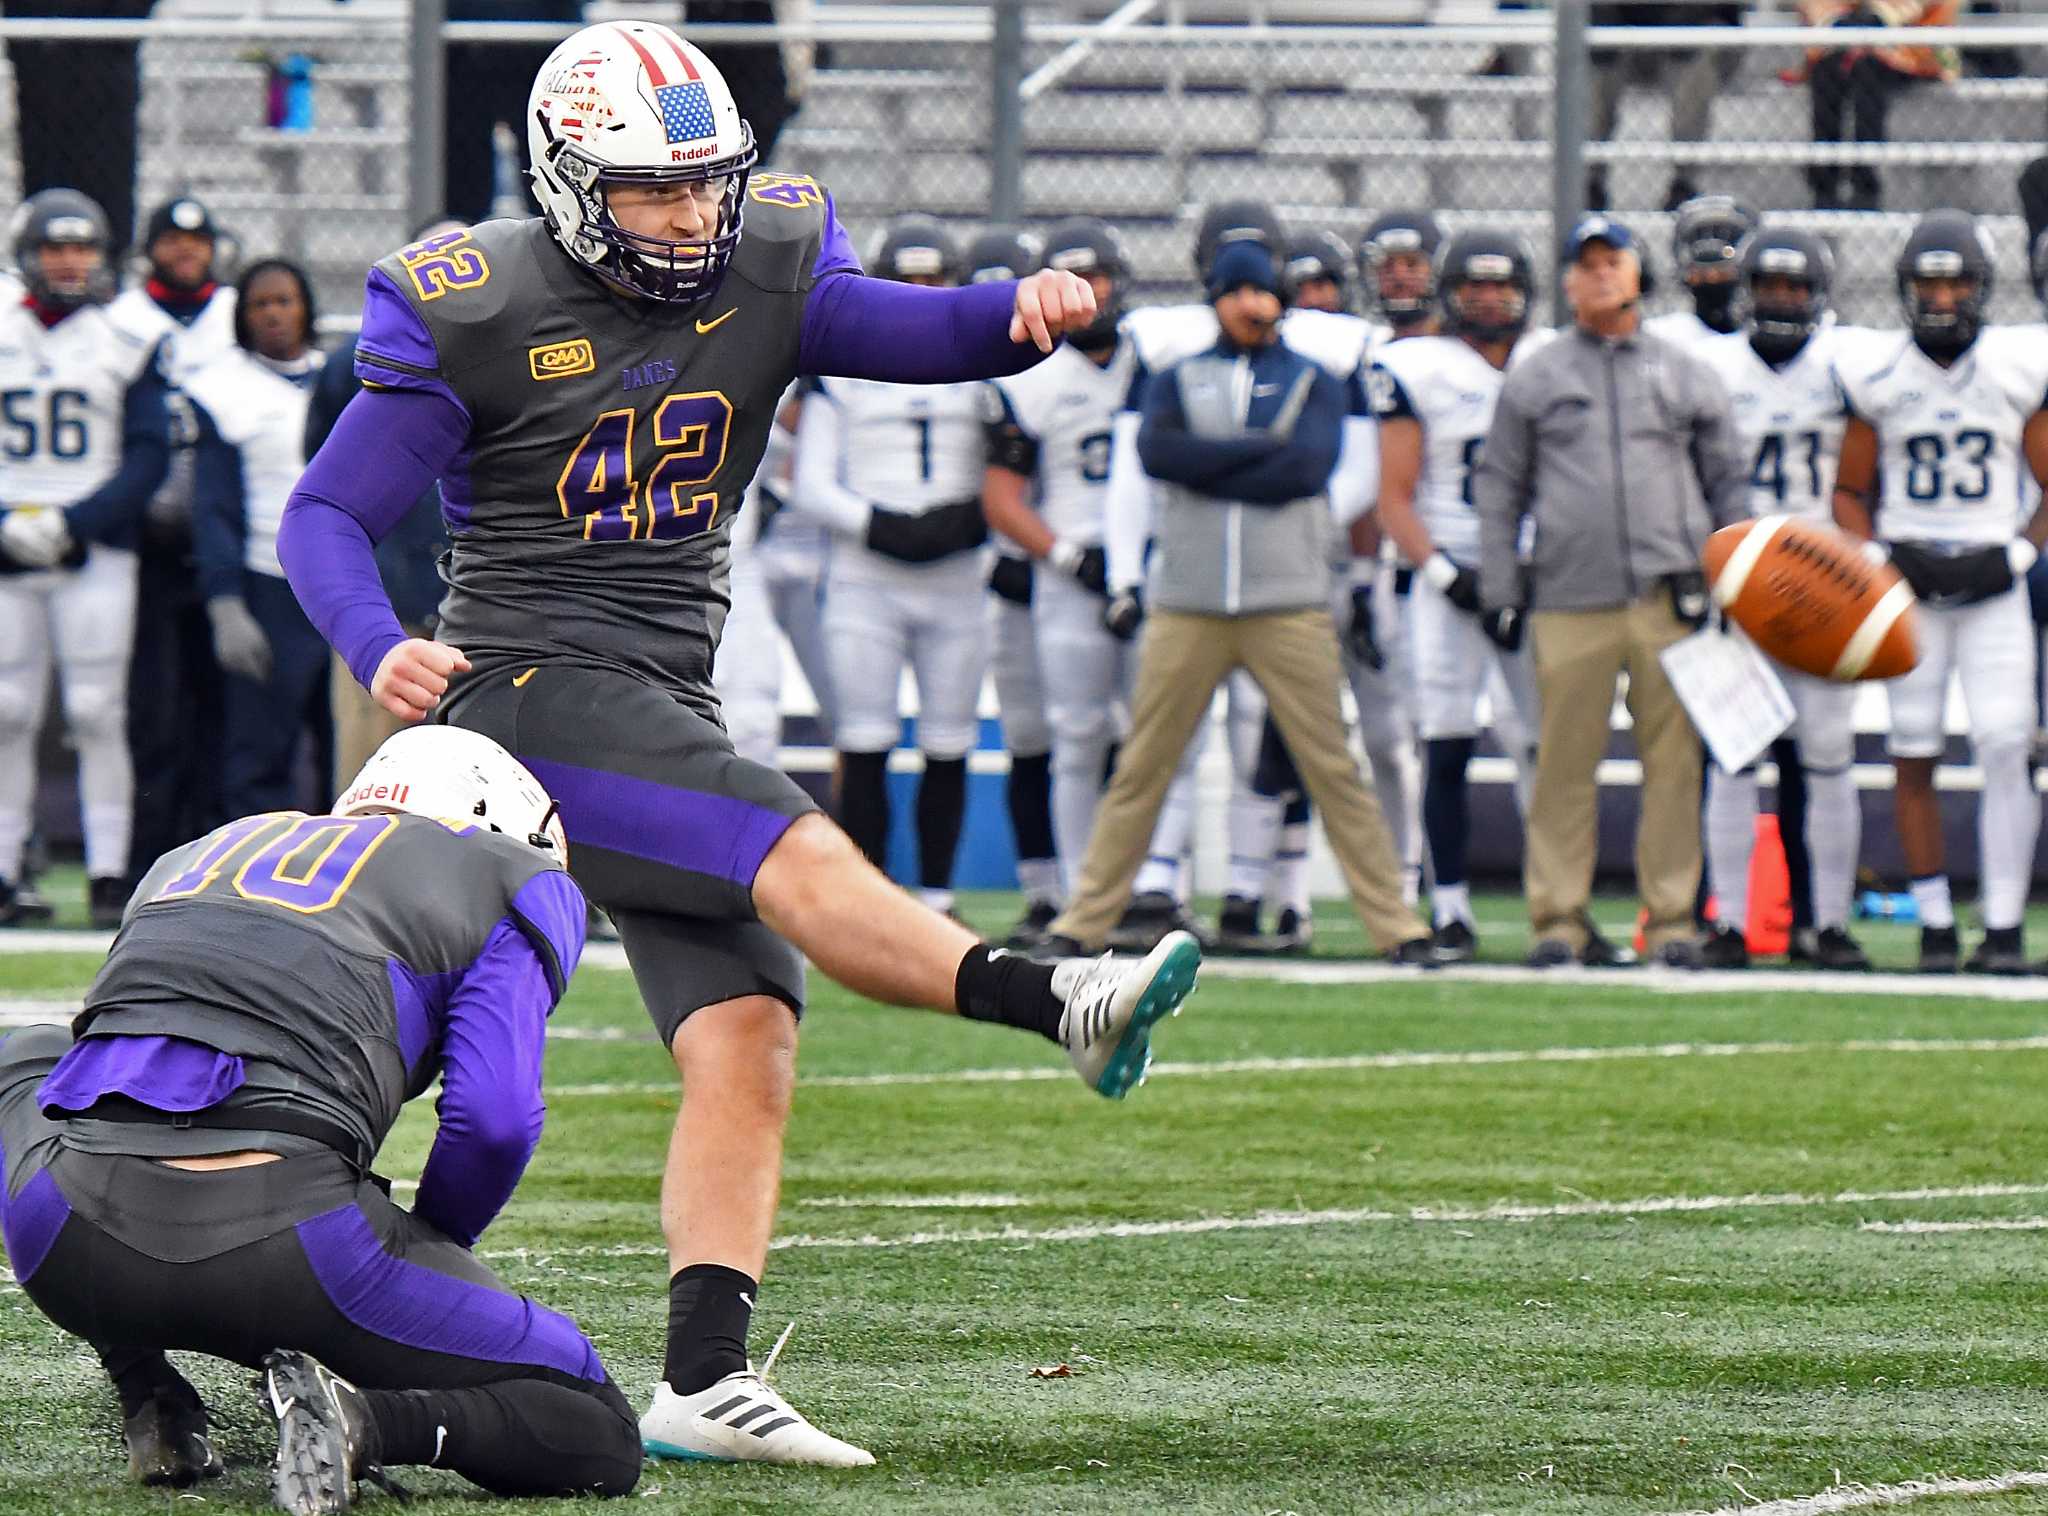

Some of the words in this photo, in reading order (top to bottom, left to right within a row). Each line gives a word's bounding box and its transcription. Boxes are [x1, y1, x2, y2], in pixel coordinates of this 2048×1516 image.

[671, 143, 718, 162] Riddell
[398, 226, 491, 302] 42
[541, 347, 580, 367] CAA
[2, 386, 90, 461] 56
[556, 390, 734, 541] 42
[1750, 430, 1821, 501] 41
[1904, 428, 1994, 501] 83
[151, 810, 400, 914] 10
